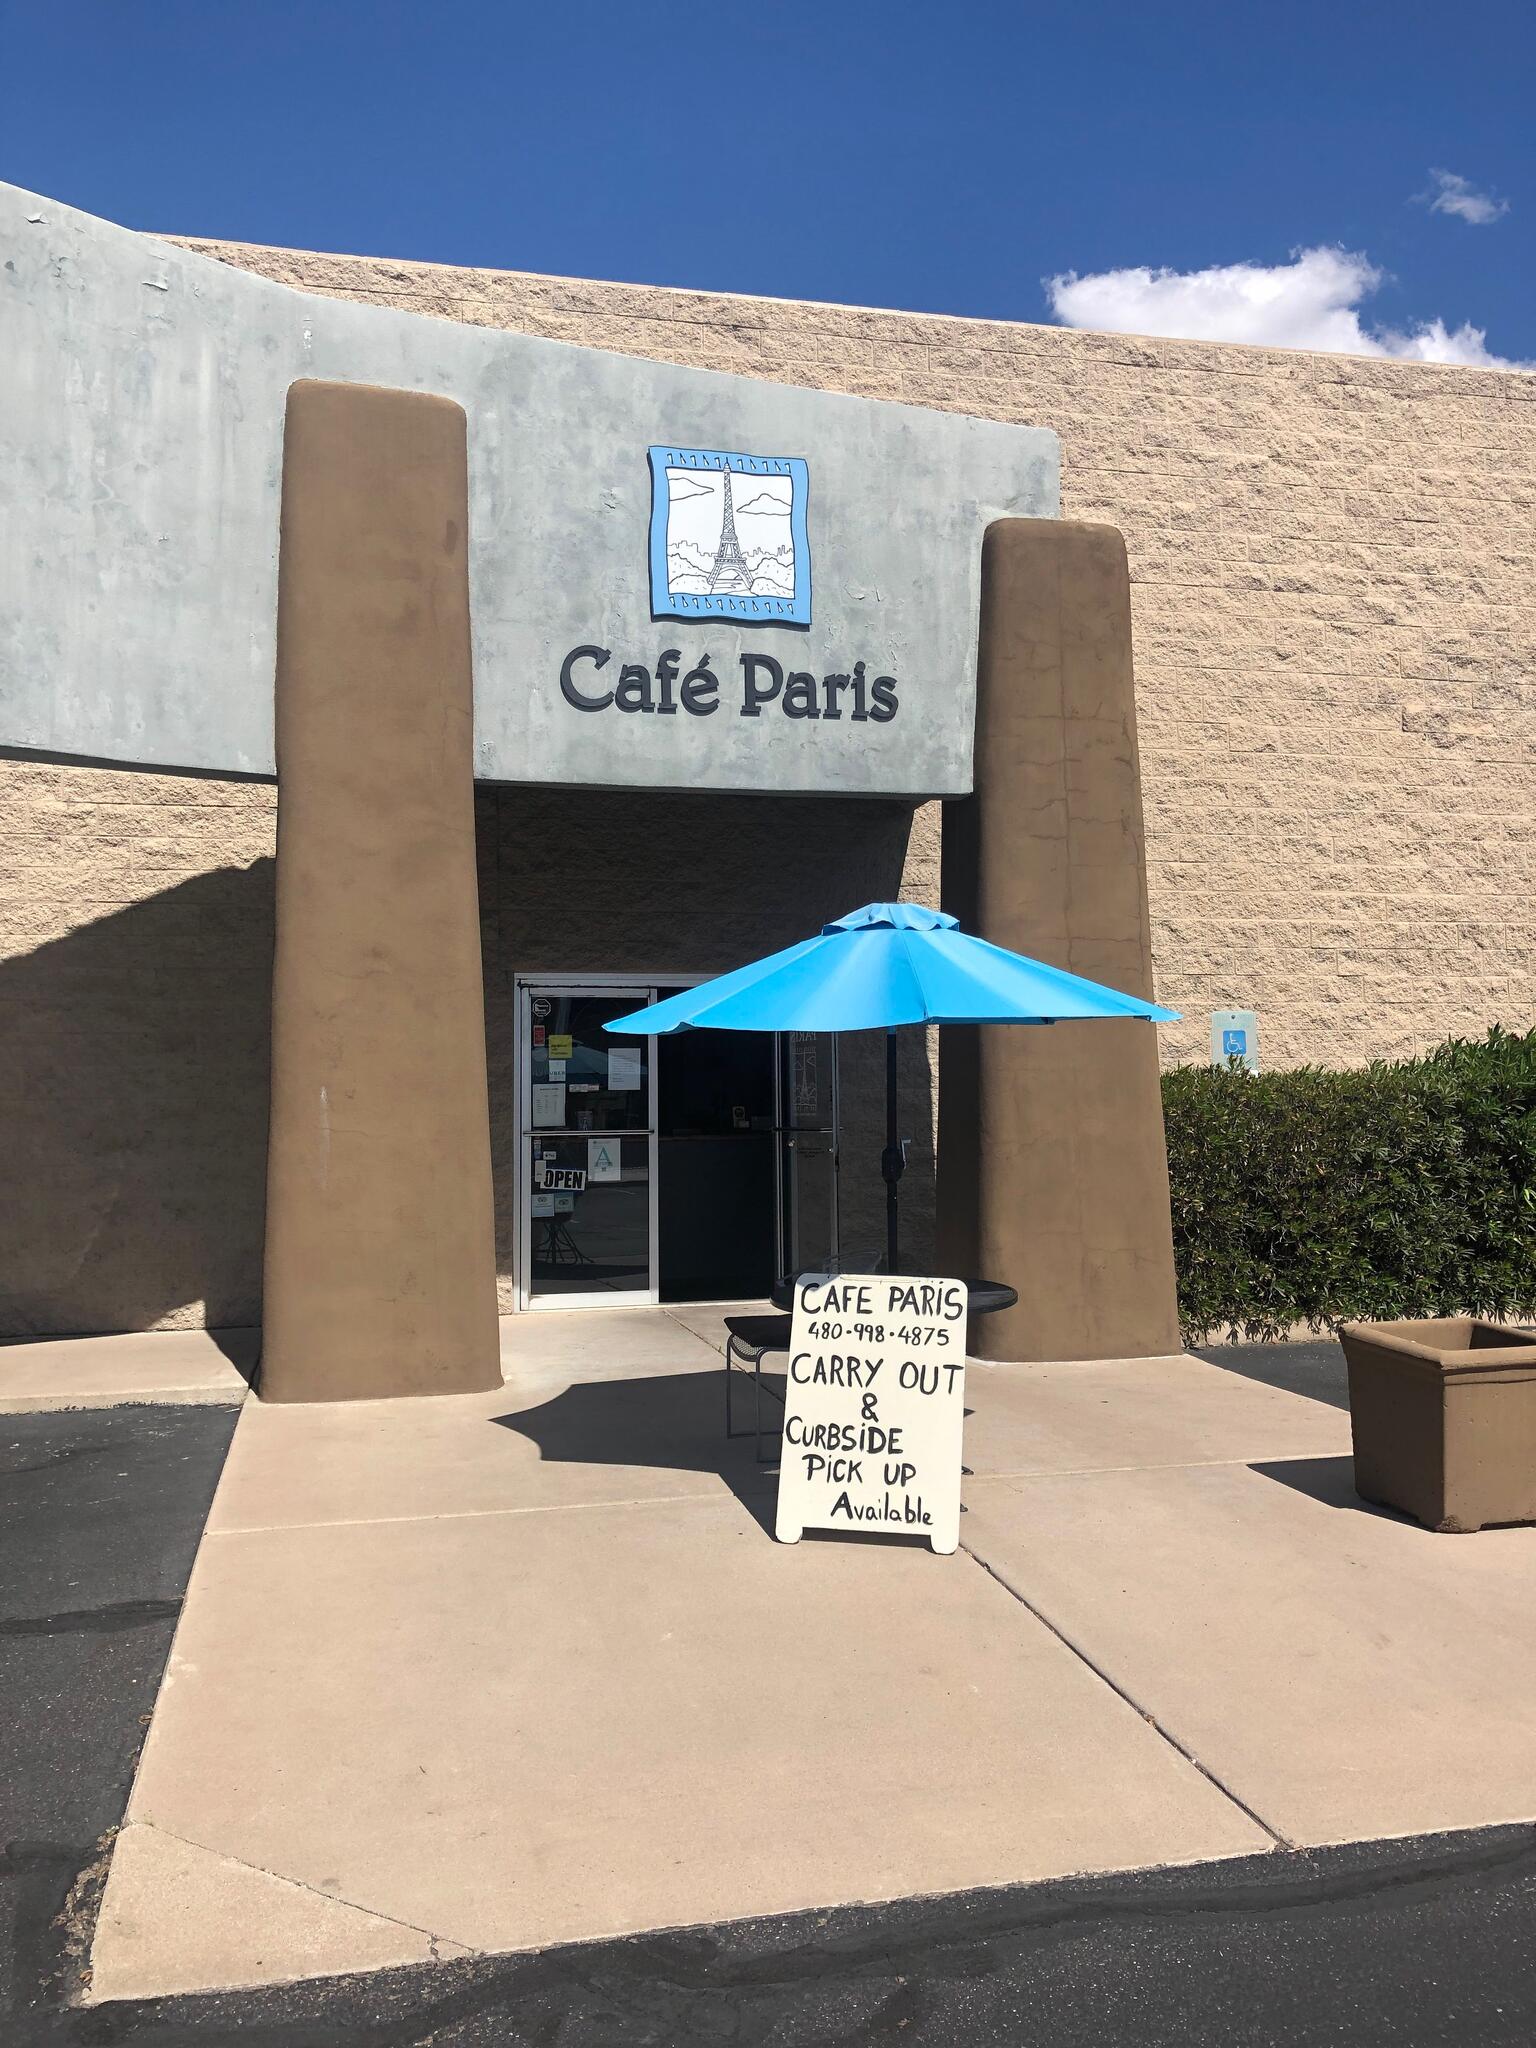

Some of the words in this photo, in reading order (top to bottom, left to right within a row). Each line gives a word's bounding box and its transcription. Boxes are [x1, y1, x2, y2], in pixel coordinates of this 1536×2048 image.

[560, 645, 720, 716] Café
[740, 653, 899, 722] Paris
[544, 1169, 583, 1189] OPEN
[800, 1283, 874, 1315] CAFE
[791, 1352, 884, 1388] CARRY
[899, 1361, 964, 1396] OUT
[860, 1392, 879, 1423] &
[883, 1462, 917, 1487] UP
[830, 1491, 934, 1526] Available
